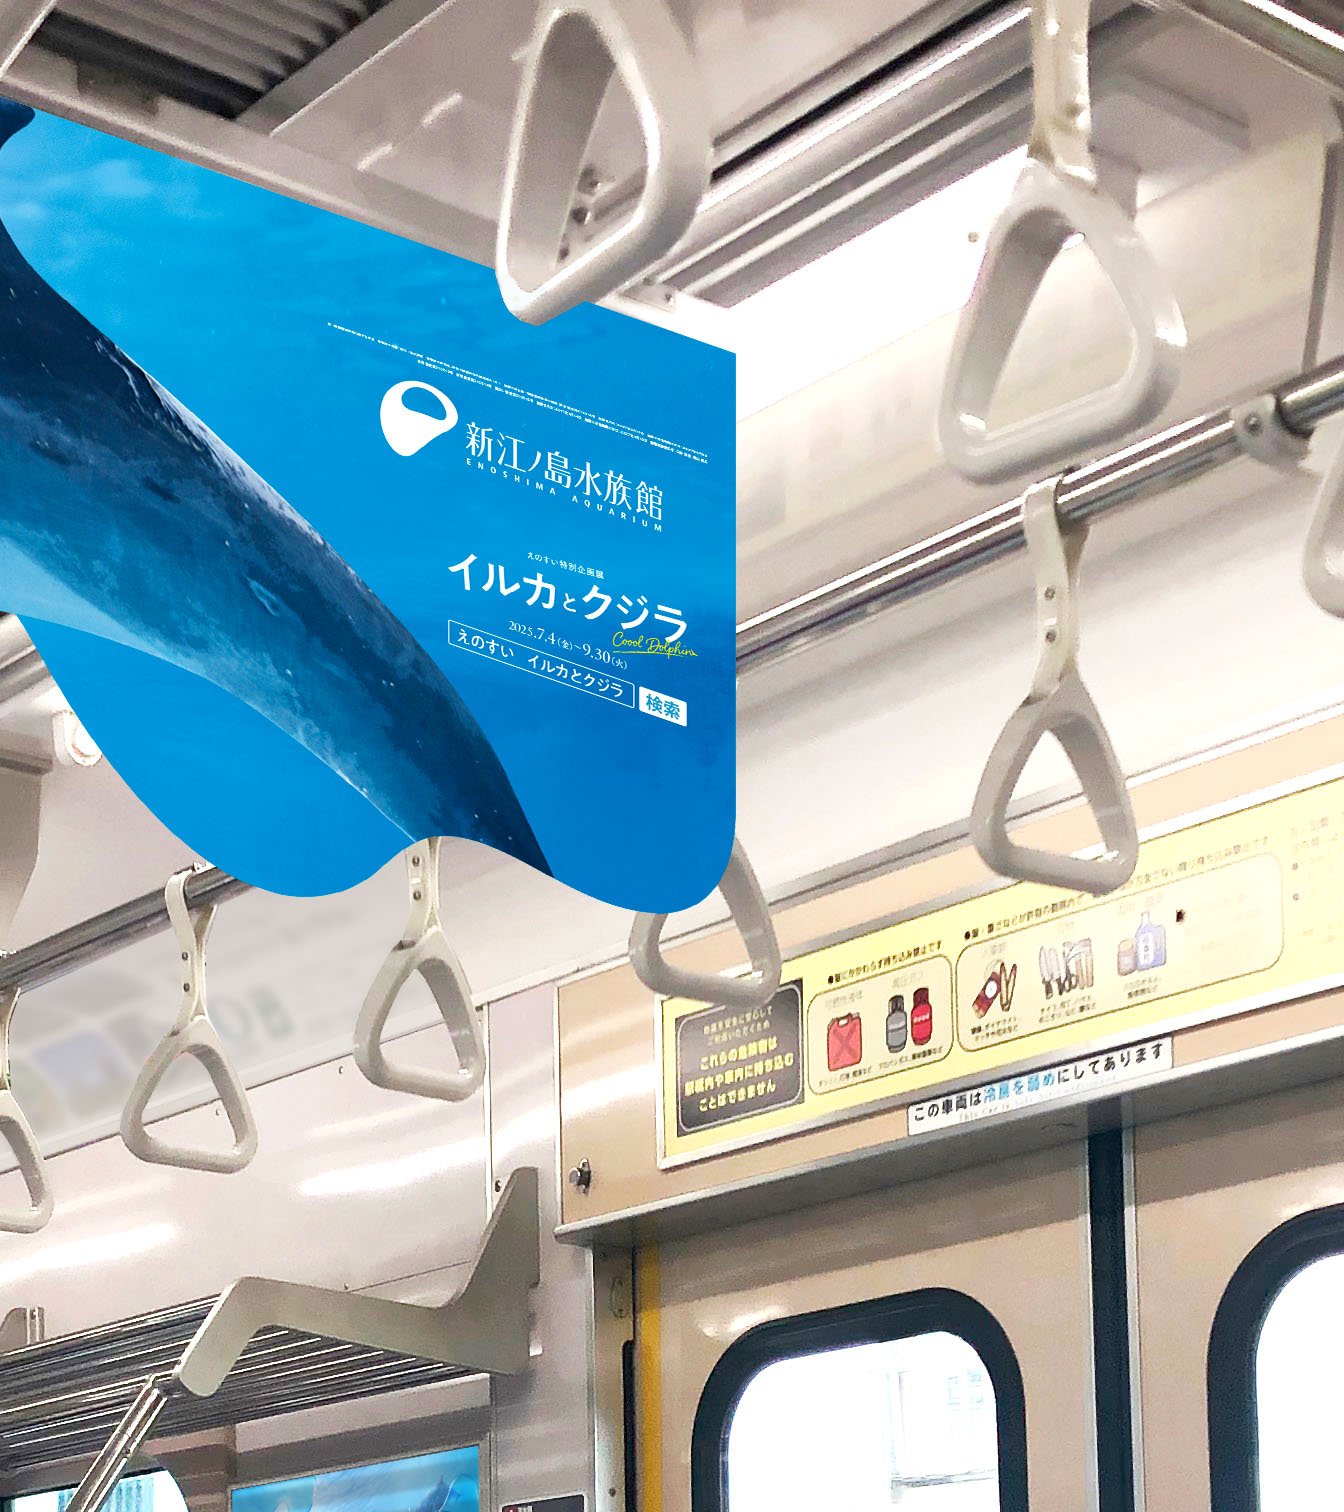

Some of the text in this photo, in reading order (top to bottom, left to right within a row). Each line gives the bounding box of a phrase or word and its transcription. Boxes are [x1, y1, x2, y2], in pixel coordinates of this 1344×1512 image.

[465, 420, 663, 521] 新江ノ島水族館
[466, 457, 663, 533] ENOSHIMA AQUARIUM
[448, 553, 688, 644] イルカとクジラ
[527, 551, 605, 580] えのすい特別企画展
[457, 628, 681, 720] えのすい イルカとクジラ 検索
[914, 1043, 1164, 1122] この車両は冷房を弱めにしてあります
